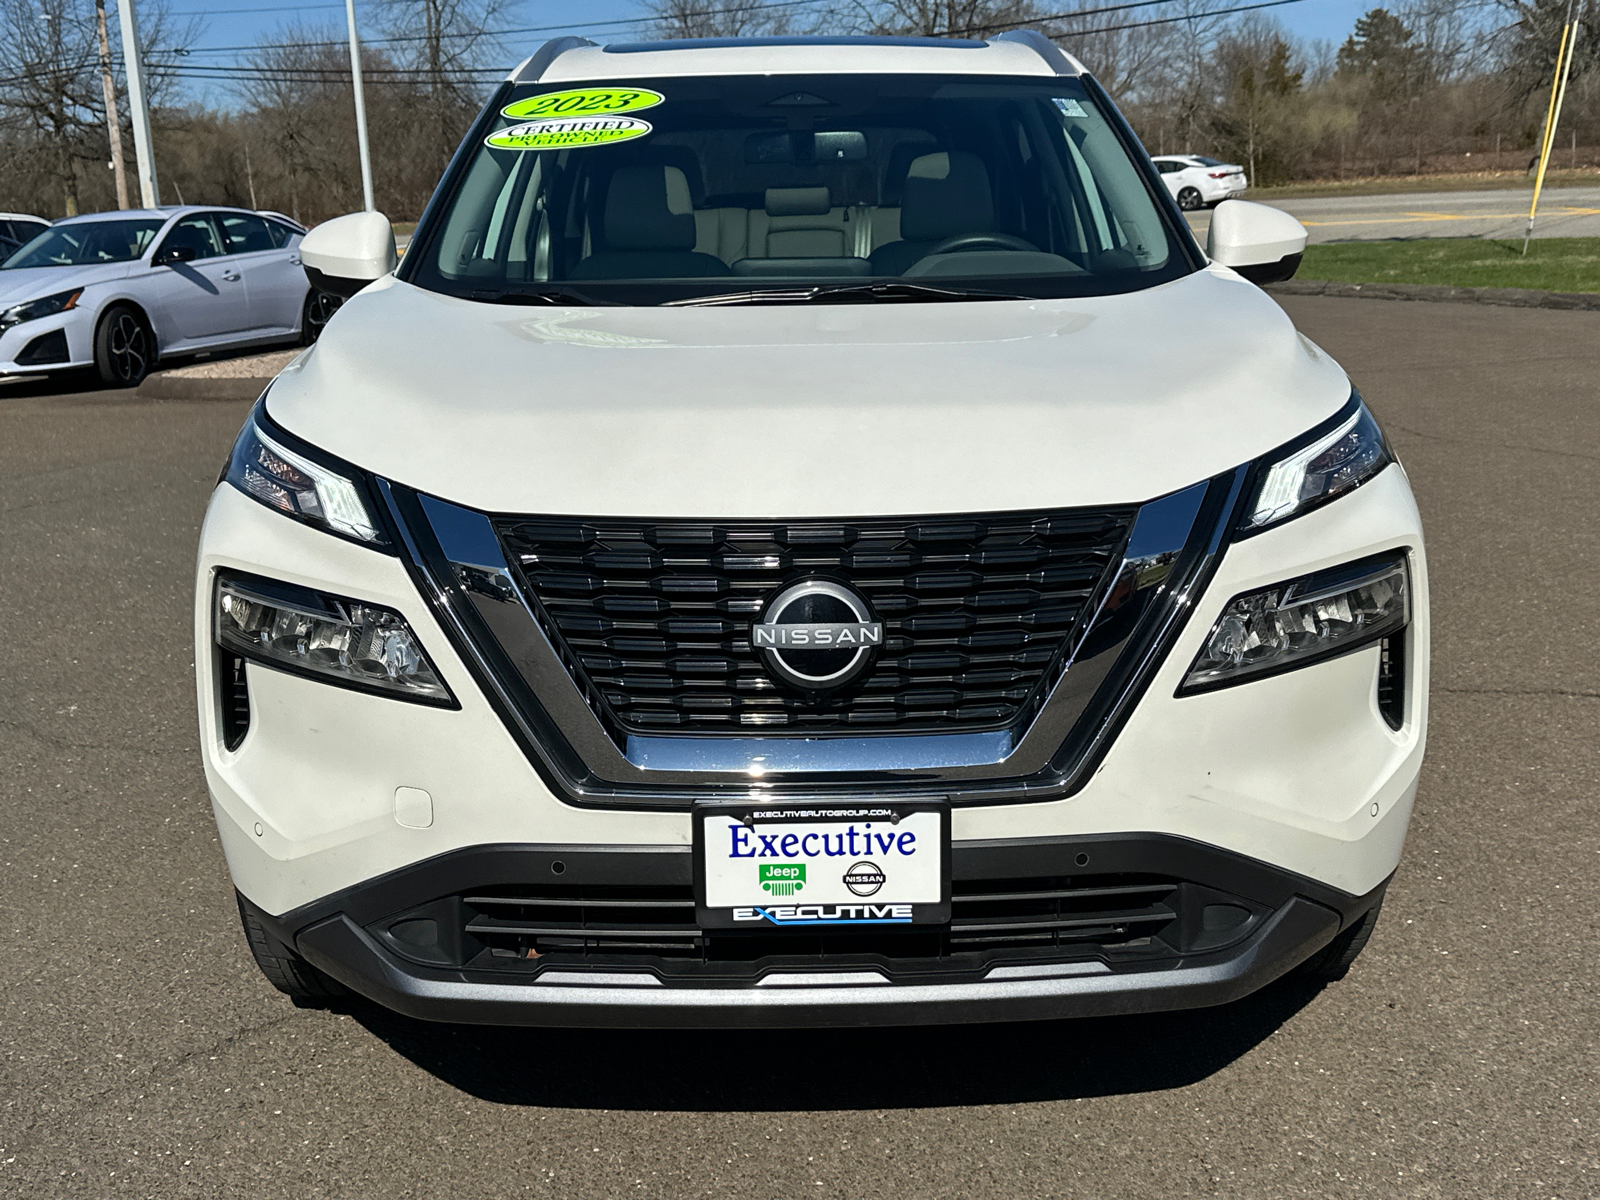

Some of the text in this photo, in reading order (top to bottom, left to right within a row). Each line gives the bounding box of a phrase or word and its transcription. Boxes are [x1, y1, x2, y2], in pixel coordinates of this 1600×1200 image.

[523, 93, 640, 116] 2023
[507, 120, 635, 137] CERTIFIED
[508, 130, 624, 143] PRE-OWNED
[524, 136, 603, 146] VEHICLE
[757, 627, 879, 644] NISSAN
[753, 809, 892, 819] EXECUTIVEAUTOGROUP.COM
[728, 823, 917, 858] Executive
[765, 866, 800, 880] Jeep
[846, 875, 884, 883] NISSAN
[733, 905, 913, 922] EXECUTIVE
